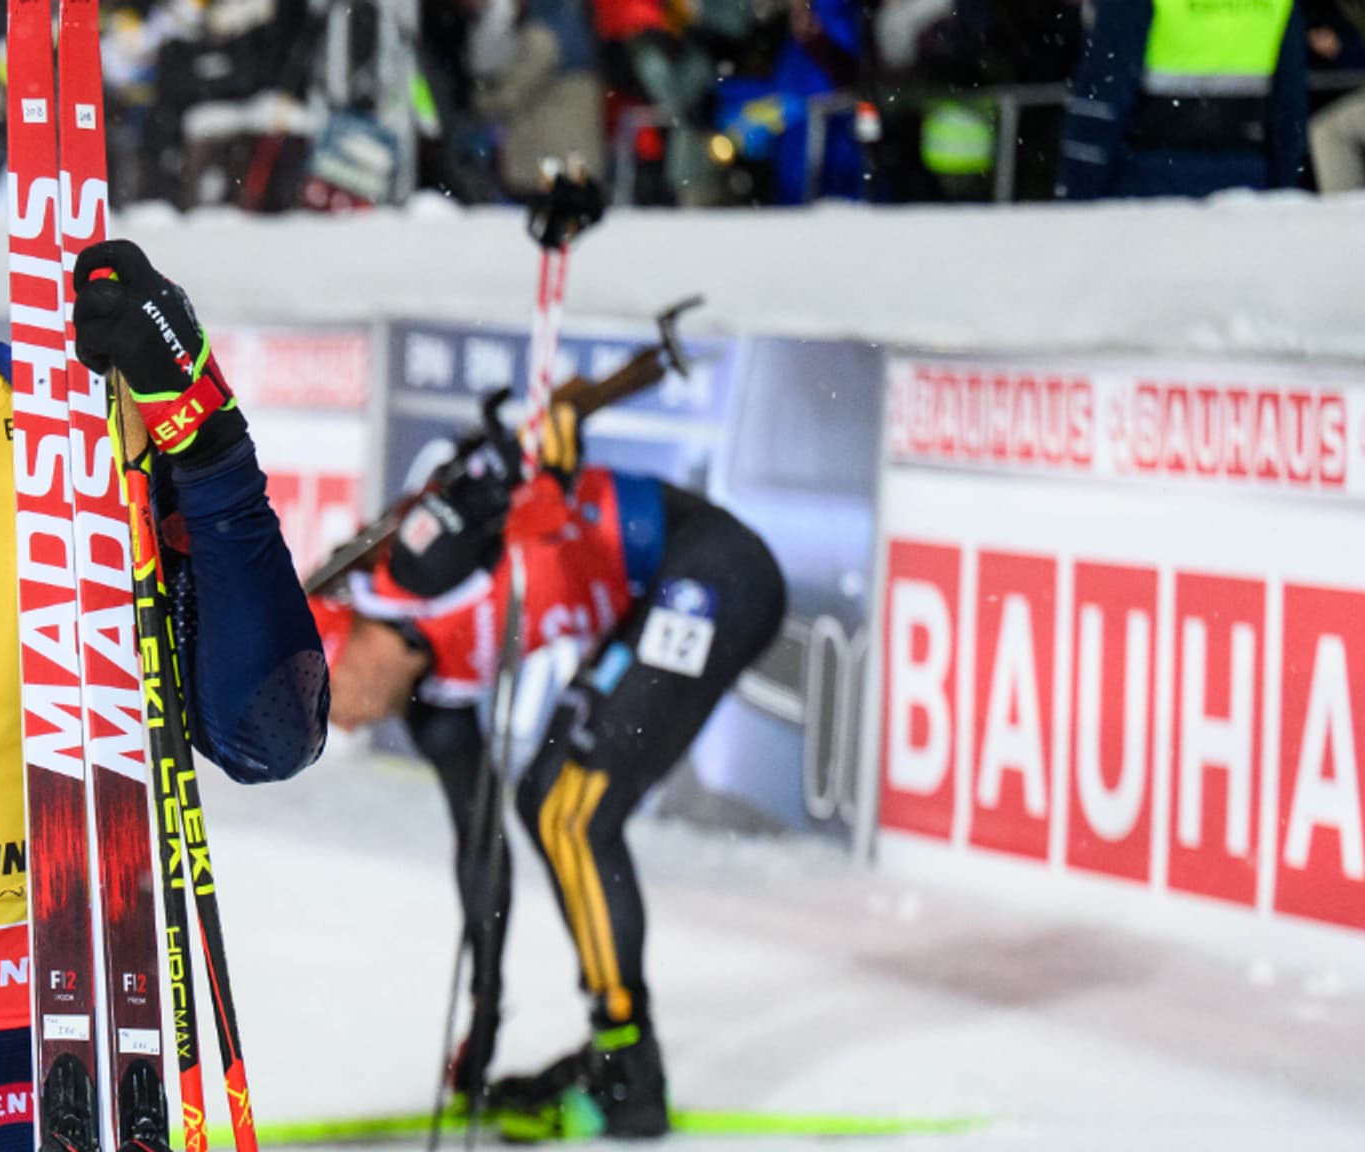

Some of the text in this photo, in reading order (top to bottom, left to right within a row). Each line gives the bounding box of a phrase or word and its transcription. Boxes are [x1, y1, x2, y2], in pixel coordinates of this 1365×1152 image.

[7, 171, 85, 781] MADSHUS
[58, 170, 149, 784] MADSS
[135, 597, 165, 729] LEKI
[160, 757, 186, 889] LEKI
[176, 769, 216, 895] LEKI
